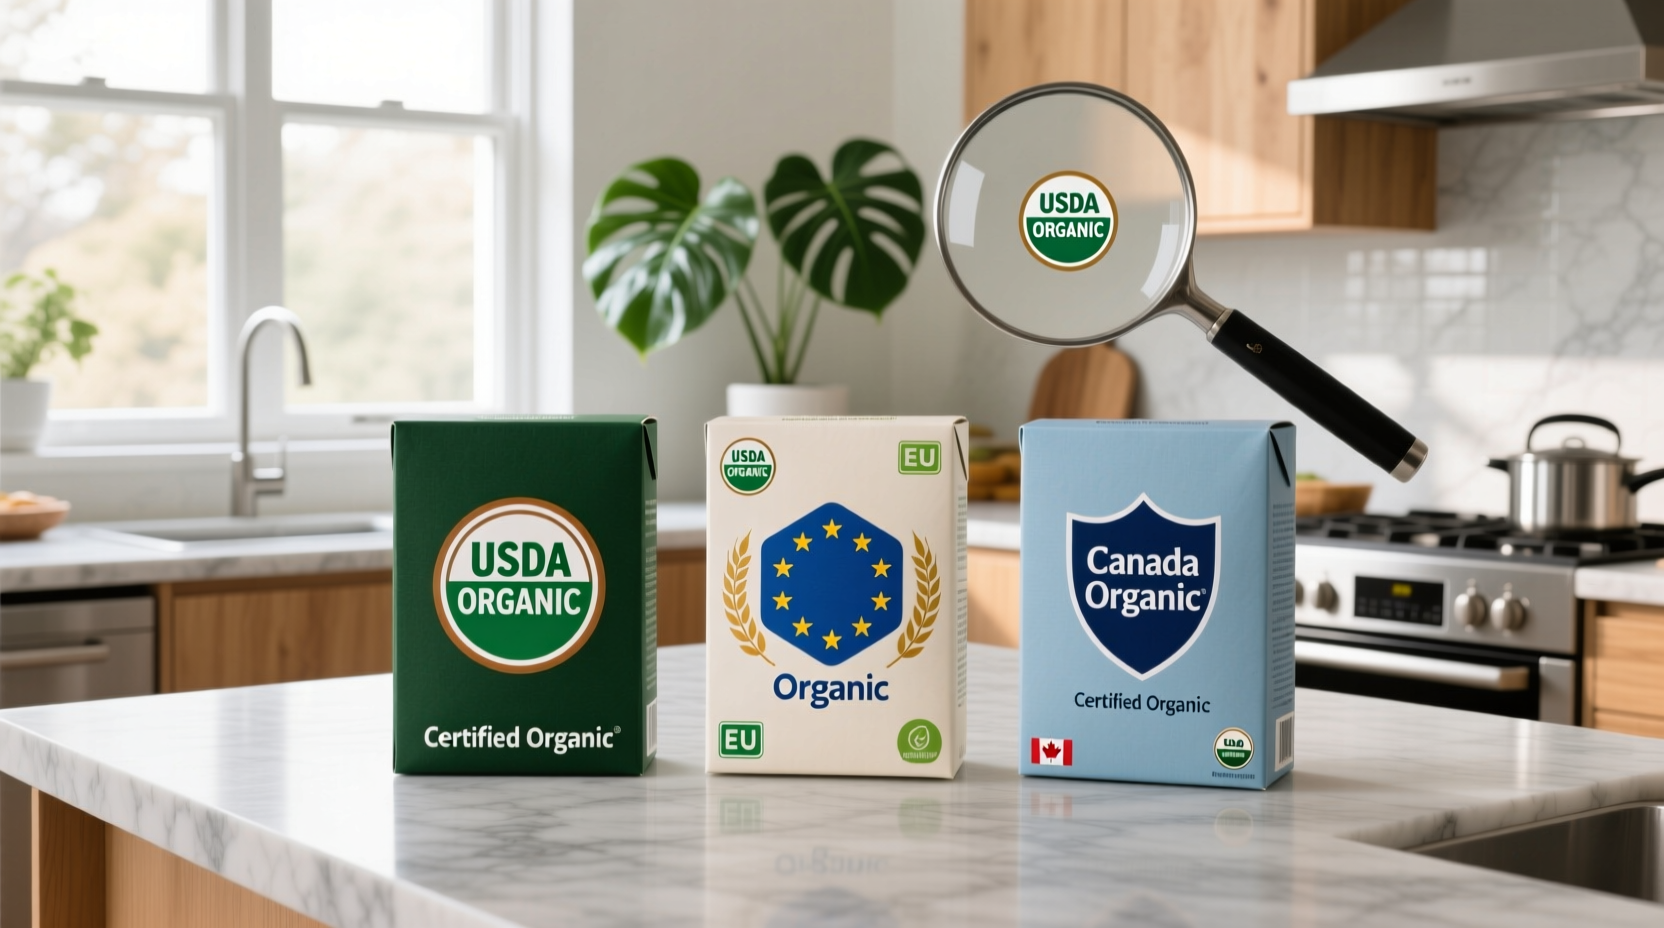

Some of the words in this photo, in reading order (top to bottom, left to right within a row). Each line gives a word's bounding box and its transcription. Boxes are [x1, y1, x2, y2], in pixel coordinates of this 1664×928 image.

[1039, 192, 1100, 214] USDA
[1032, 221, 1104, 238] ORGANIC
[731, 449, 766, 463] USDA
[904, 448, 935, 467] EU
[471, 541, 572, 578] USDA
[1086, 545, 1200, 577] Canada
[457, 587, 582, 616] ORGANIC
[773, 673, 889, 710] Organic
[1074, 692, 1142, 710] Certified
[1146, 694, 1211, 716] Organic
[424, 725, 520, 748] Certified
[725, 729, 757, 751] EU
